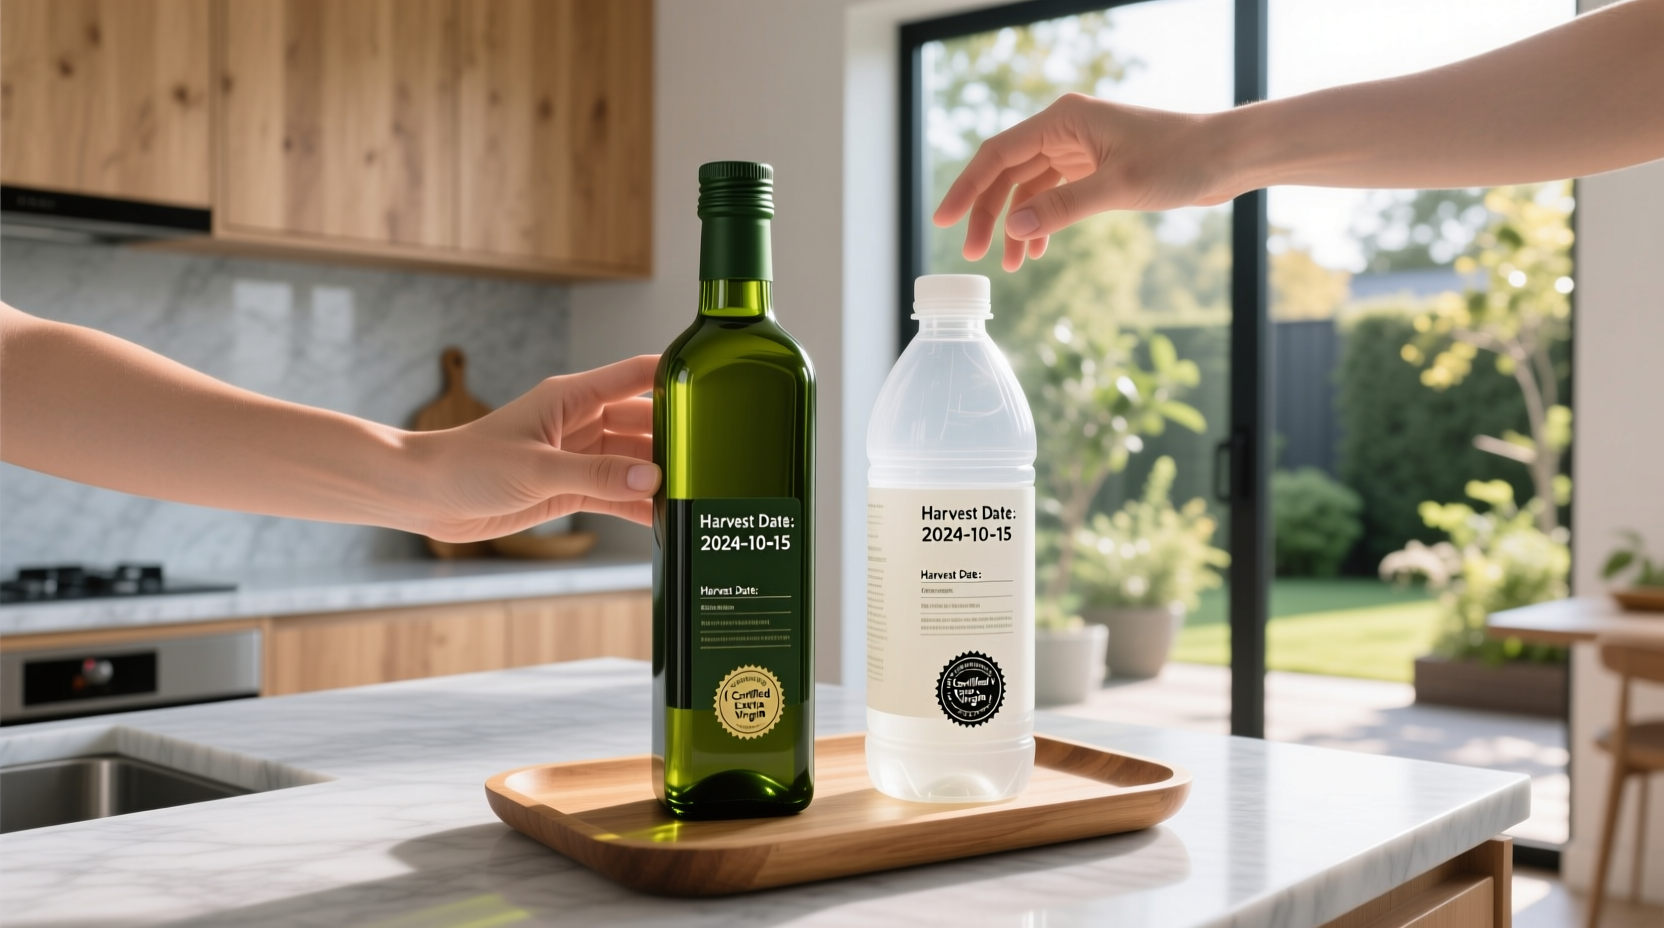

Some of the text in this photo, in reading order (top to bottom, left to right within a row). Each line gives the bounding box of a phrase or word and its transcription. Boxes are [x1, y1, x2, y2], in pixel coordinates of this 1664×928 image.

[921, 505, 1016, 520] Harvest Date:
[700, 514, 795, 528] Harvest Date:
[921, 527, 1012, 542] 2024-10-15
[700, 535, 791, 551] 2024-10-15
[920, 569, 957, 580] Harvest
